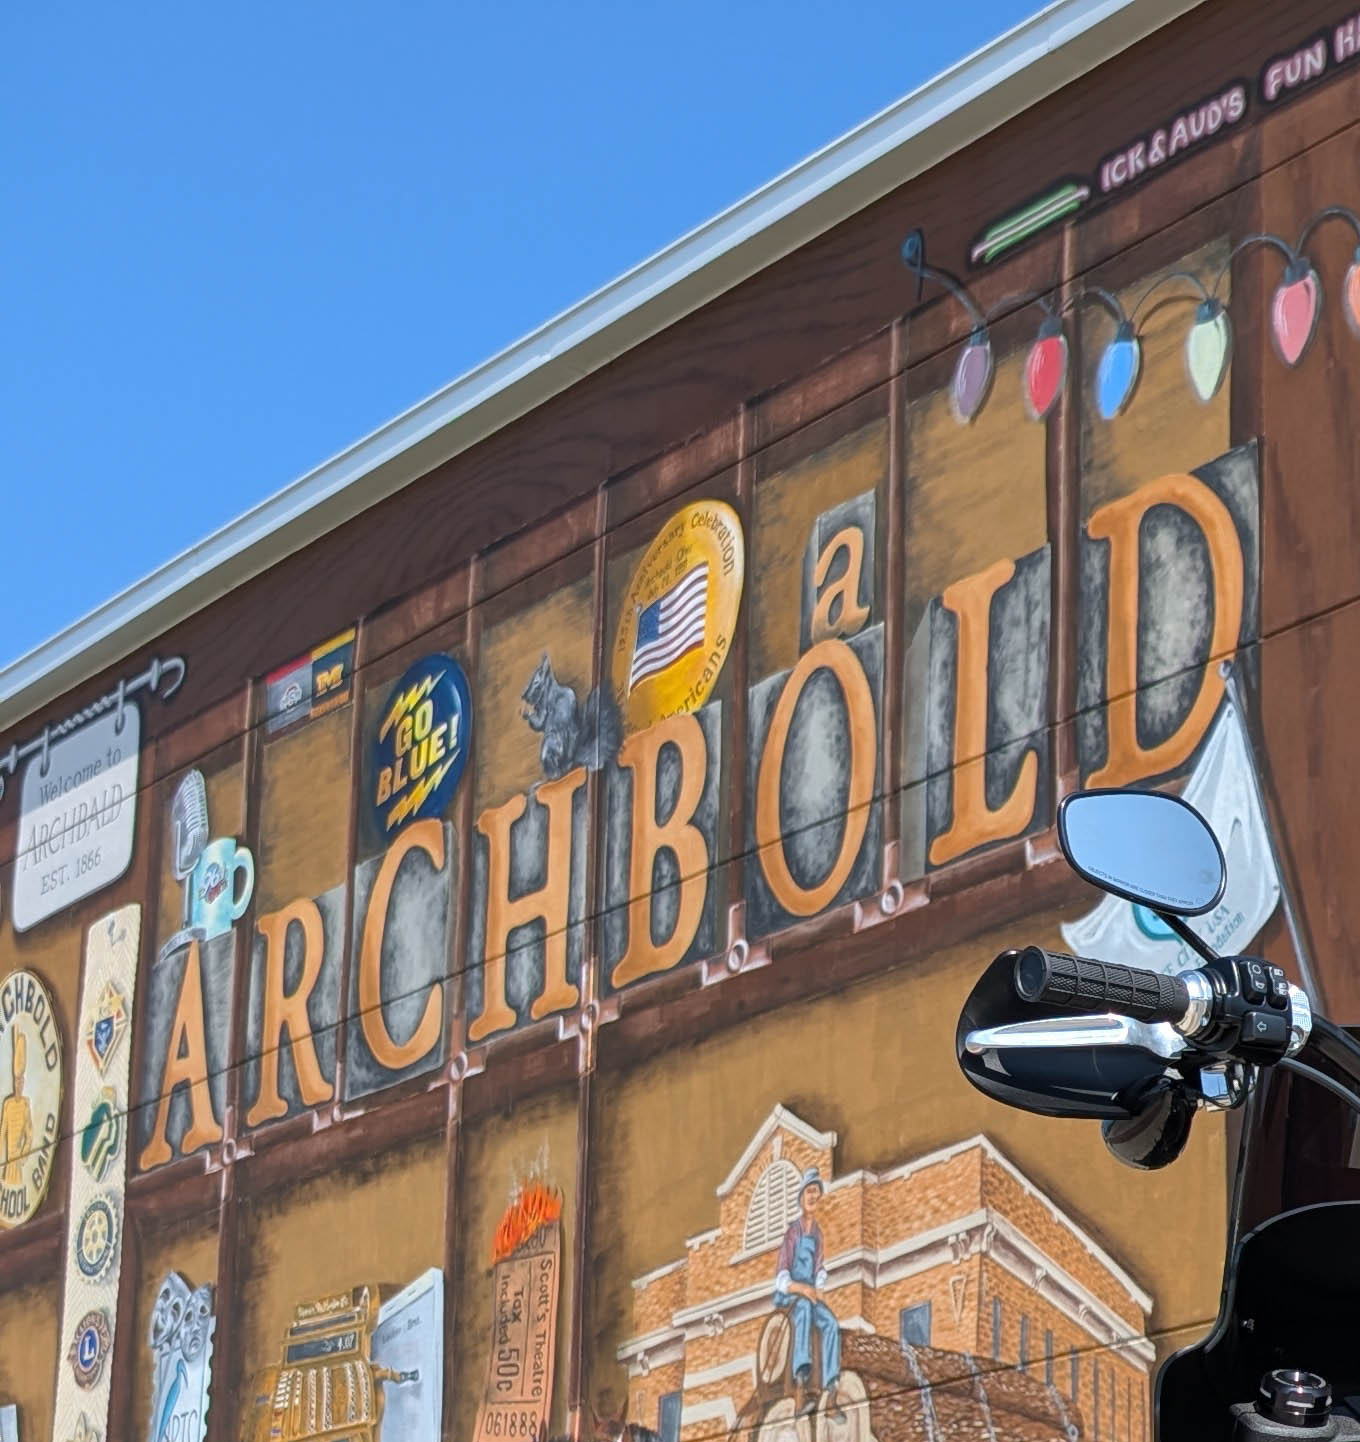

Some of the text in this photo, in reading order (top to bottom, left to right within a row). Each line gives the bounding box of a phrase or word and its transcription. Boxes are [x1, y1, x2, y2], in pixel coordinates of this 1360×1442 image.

[1263, 39, 1327, 102] FUN
[691, 510, 736, 577] Celebration
[376, 712, 460, 808] BLUE!
[395, 699, 434, 758] GO
[39, 746, 123, 806] Welcome to
[138, 472, 1244, 1171] ARCHBOLD
[40, 847, 102, 896] EST. 1866
[0, 975, 58, 1073] CHBOLD
[31, 1111, 56, 1191] BAND
[530, 1258, 554, 1398] Scott's Theatre
[484, 1410, 539, 1439] 061888
